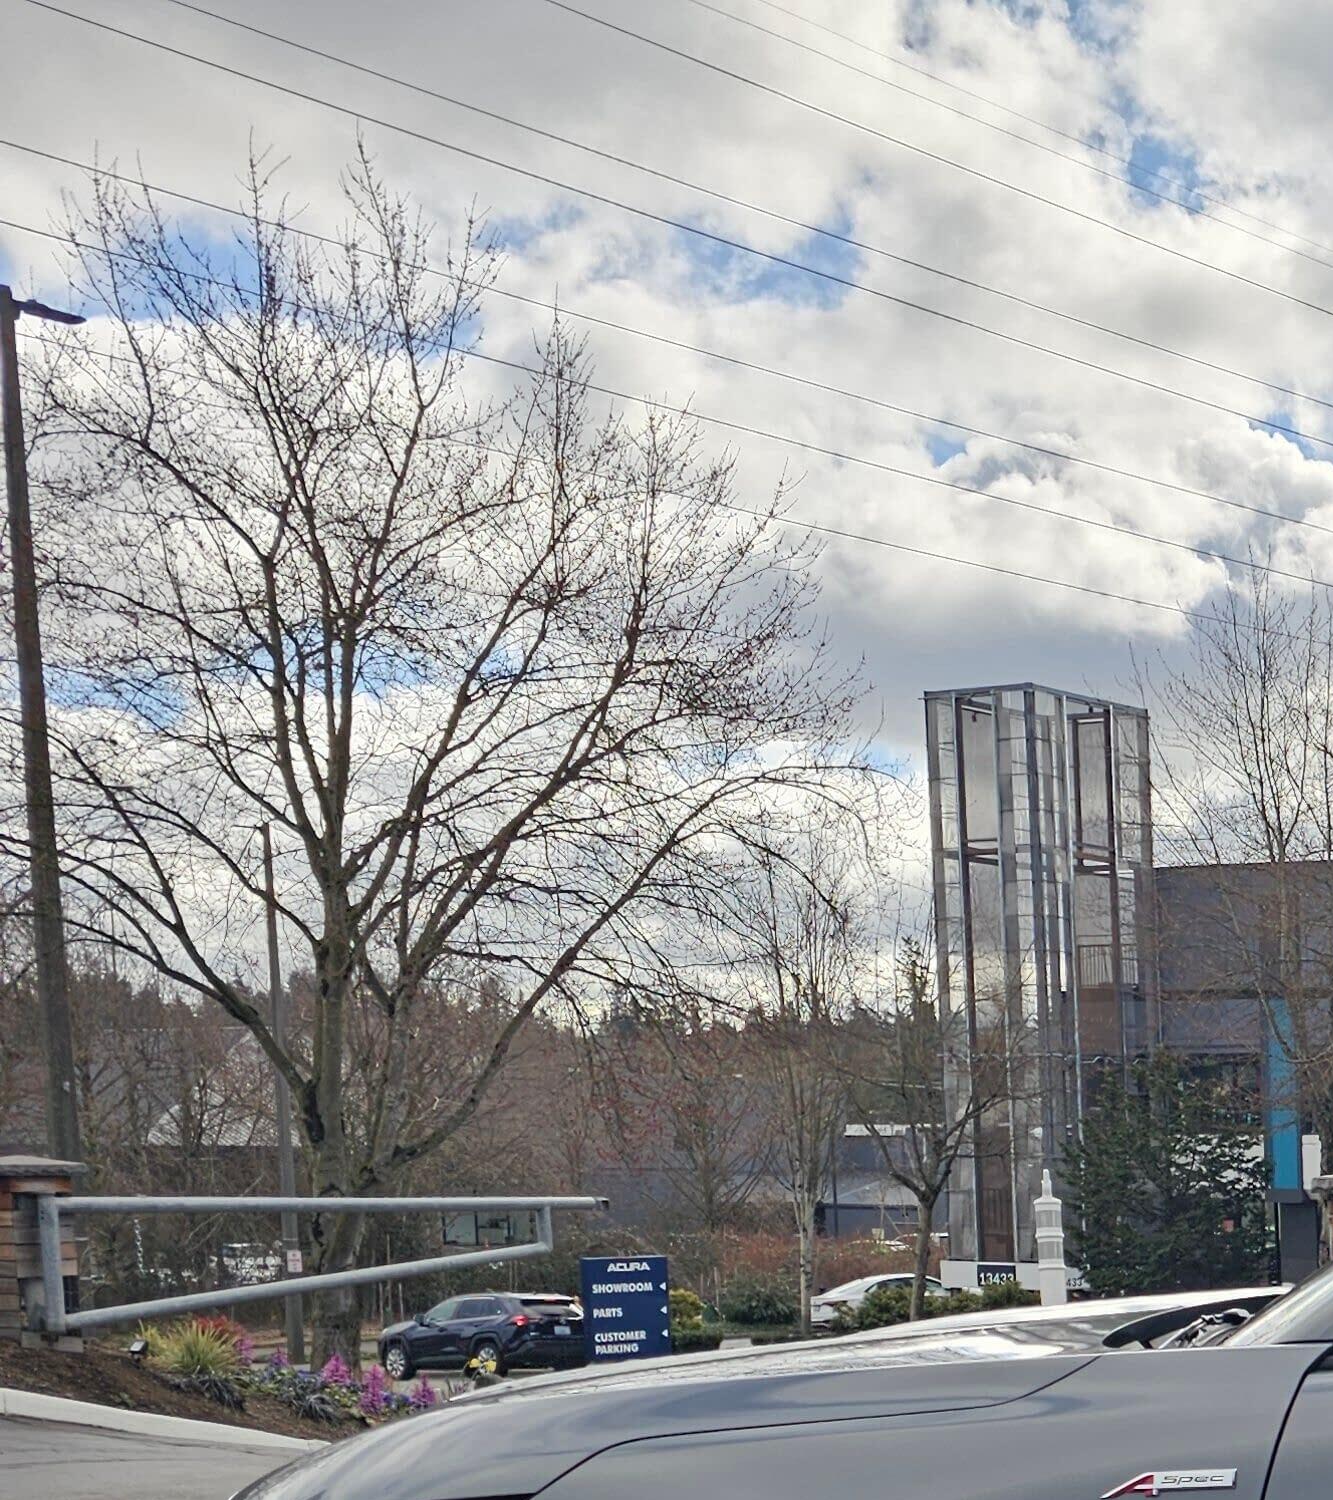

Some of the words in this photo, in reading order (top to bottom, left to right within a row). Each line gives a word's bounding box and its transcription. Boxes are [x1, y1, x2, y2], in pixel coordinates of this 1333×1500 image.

[607, 1262, 650, 1272] ACURA
[979, 1272, 1015, 1285] 13433
[592, 1282, 653, 1294] SHOWROOM
[593, 1307, 623, 1318] PARTS
[594, 1330, 647, 1342] CUSTOMER
[595, 1343, 639, 1355] PARKING
